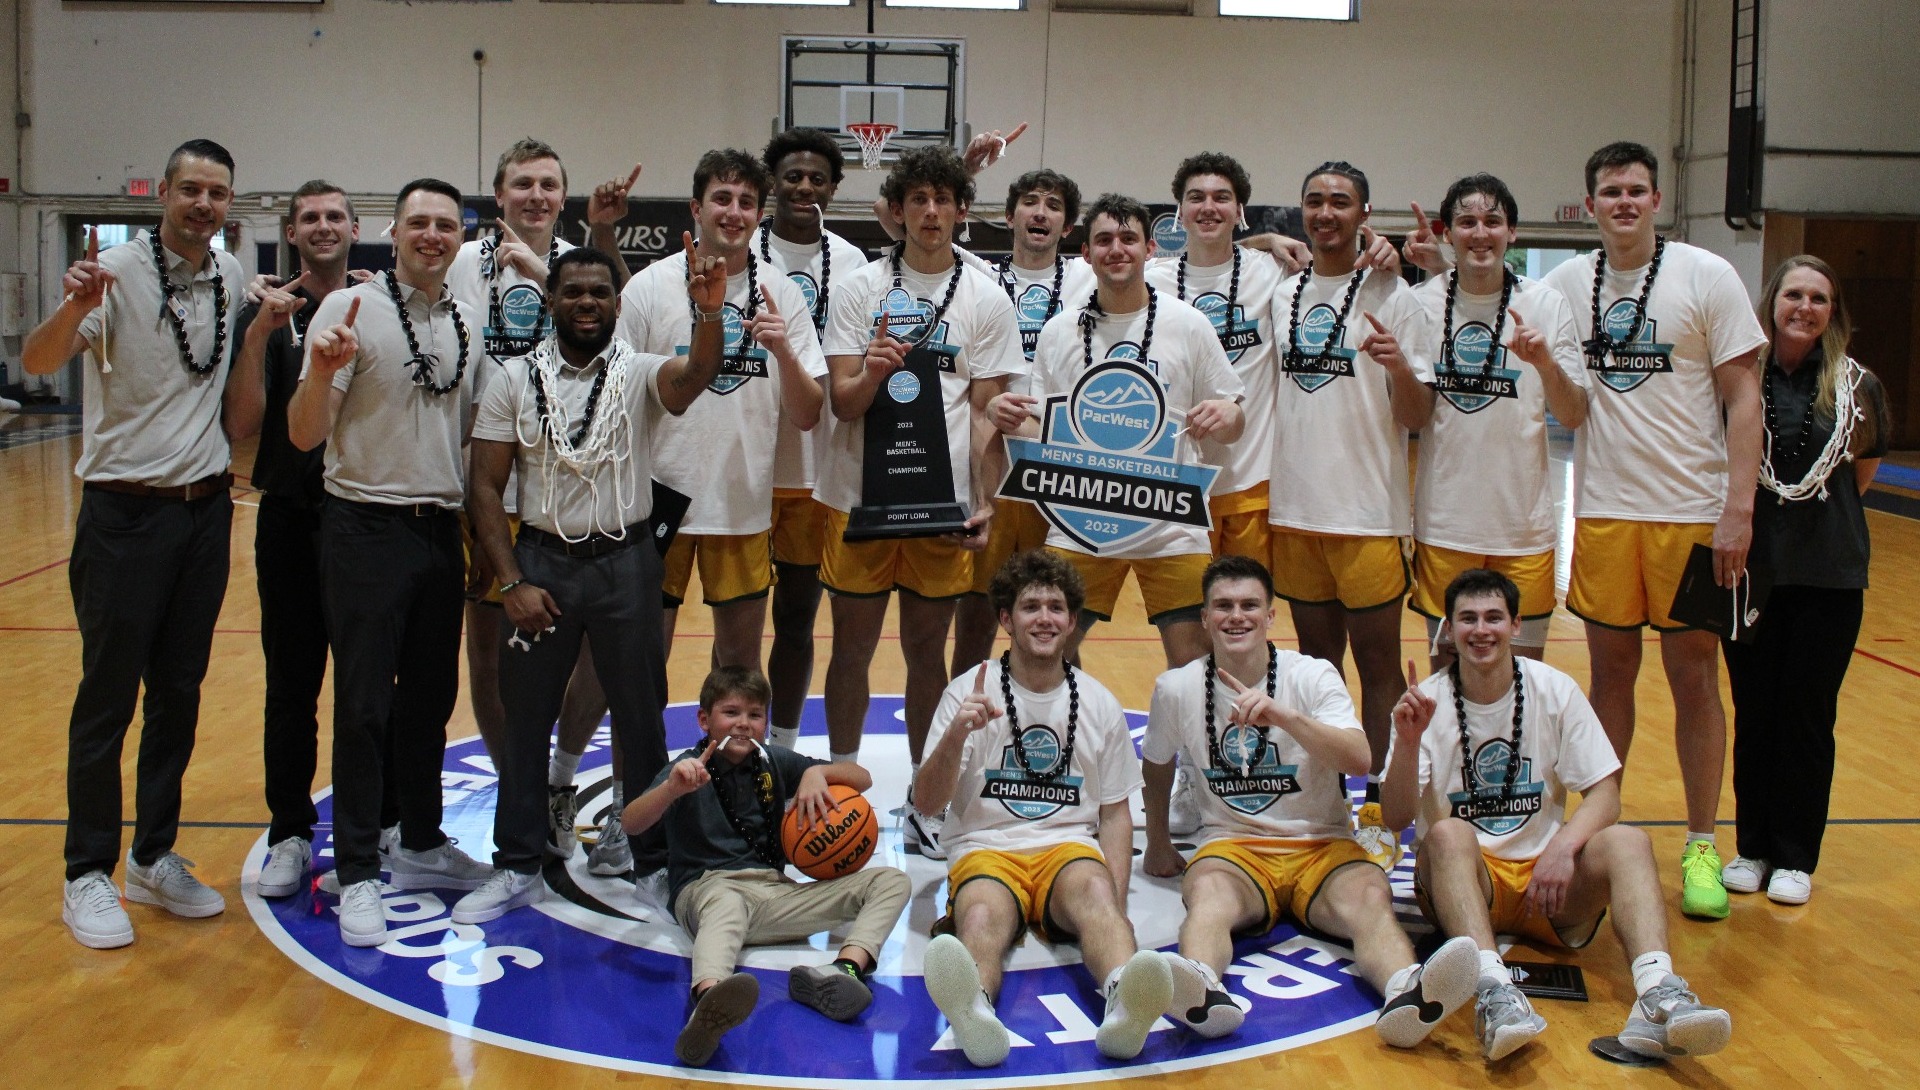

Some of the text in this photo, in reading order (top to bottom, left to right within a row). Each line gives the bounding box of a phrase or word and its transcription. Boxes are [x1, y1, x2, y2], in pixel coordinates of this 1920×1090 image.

[1563, 205, 1581, 220] EXIT
[578, 219, 668, 251] YURS
[506, 308, 539, 316] PacWest
[877, 316, 922, 326] CAMPIONS
[1082, 408, 1150, 430] PacWest
[895, 440, 917, 448] MEN'S
[886, 448, 927, 456] BASKETBALL
[888, 466, 927, 475] CHAMPIONS
[1041, 448, 1179, 479] MEN'S BASKETBALL
[1021, 468, 1193, 515] CHAMPIONS
[887, 513, 909, 521] POINT
[1083, 519, 1120, 535] 2023
[1025, 751, 1055, 760] acWest
[990, 782, 1076, 802] CHAMPIONS
[1493, 821, 1510, 829] 2023
[804, 808, 862, 858] Wilson
[832, 835, 872, 873] NCAA
